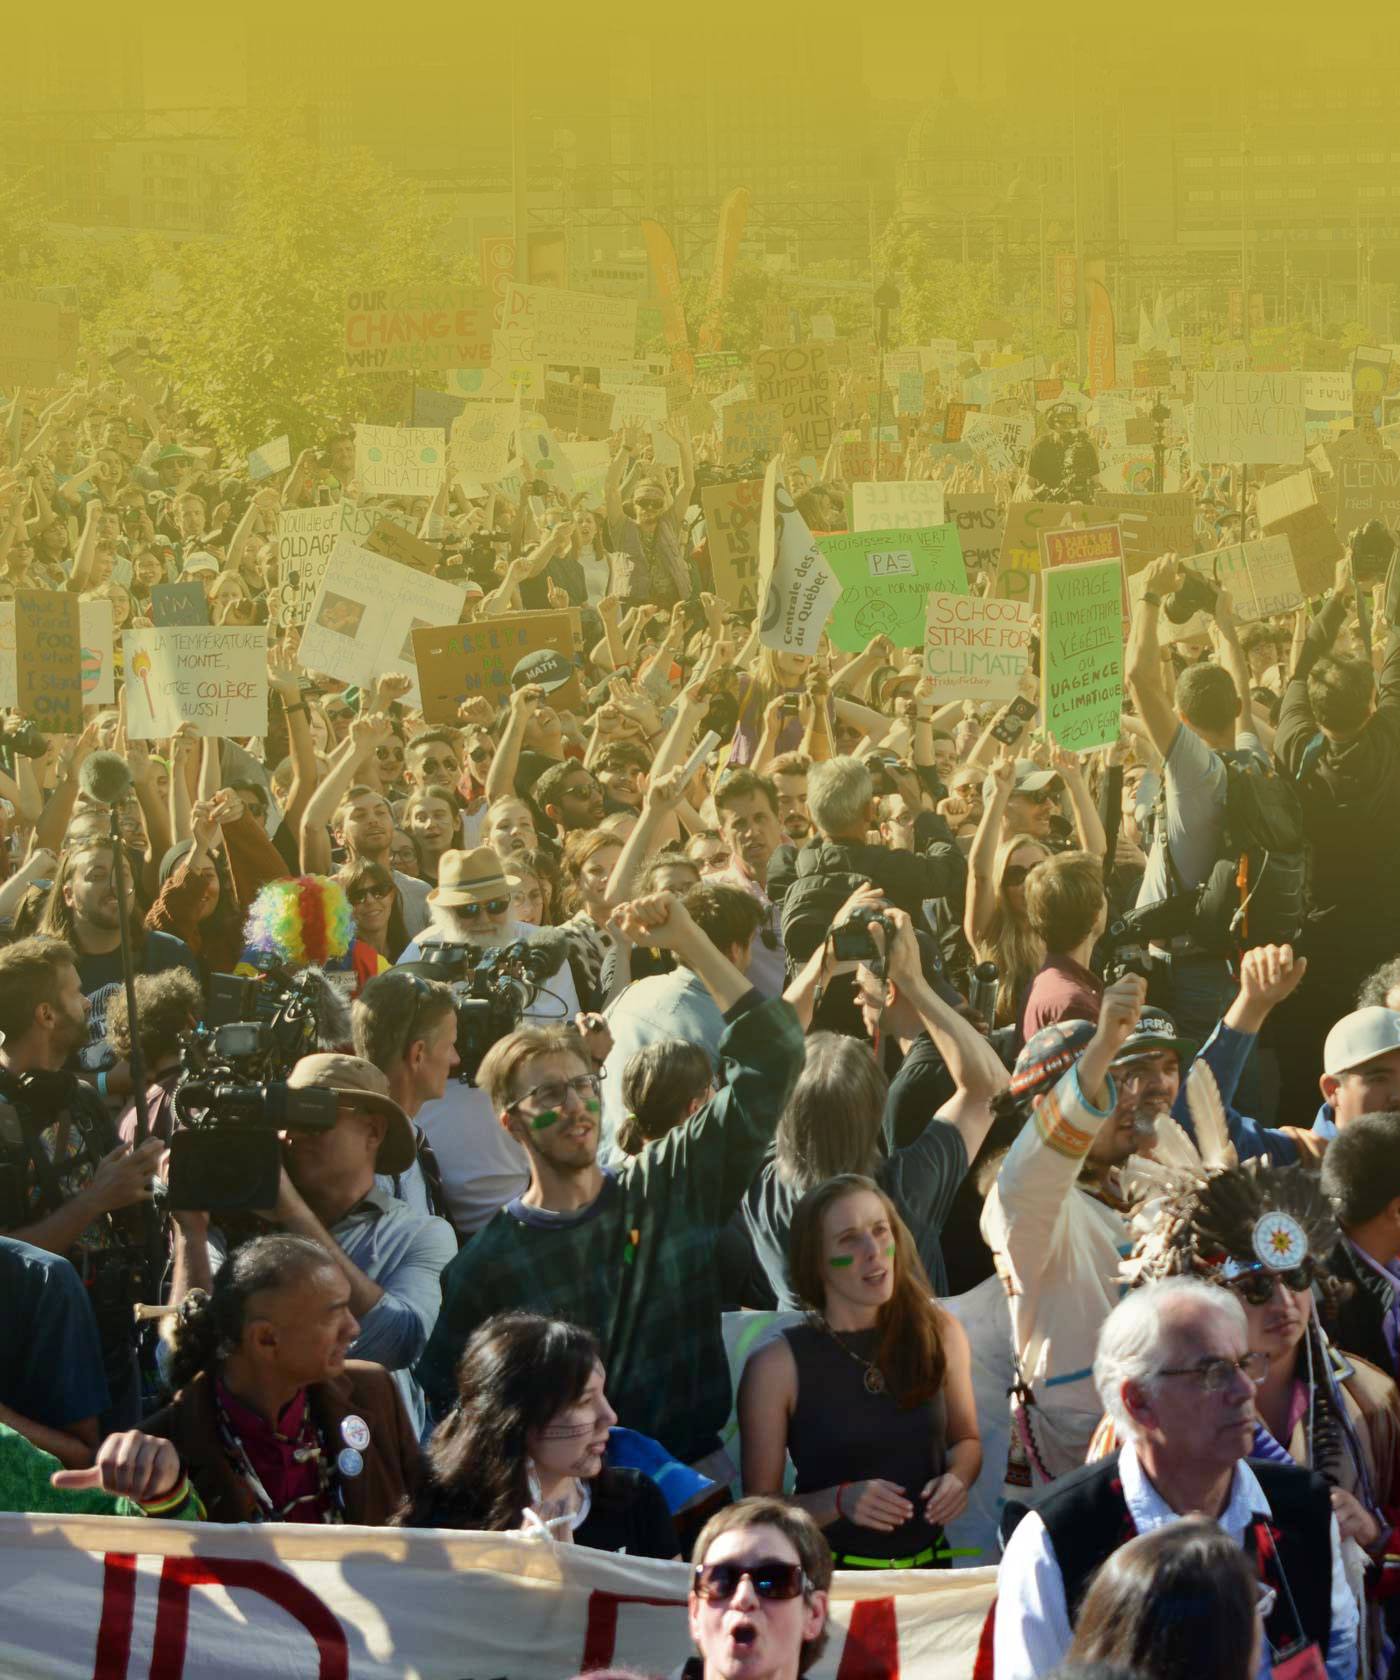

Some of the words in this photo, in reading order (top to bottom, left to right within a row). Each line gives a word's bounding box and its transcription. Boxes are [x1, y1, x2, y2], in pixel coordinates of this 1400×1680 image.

[349, 290, 387, 312] OUR
[346, 309, 480, 348] CHANGE
[347, 348, 388, 368] WHY
[456, 344, 492, 361] WE
[756, 347, 826, 380] STOP
[758, 371, 829, 403] PIMPING
[280, 535, 308, 561] OLD
[917, 530, 948, 548] VERT
[1066, 542, 1115, 560] OCTOBRE
[871, 551, 913, 574] PAS
[1056, 572, 1112, 601] VIRAGE
[783, 573, 807, 646] Centrale
[799, 554, 816, 579] des
[797, 571, 830, 631] Québec
[936, 597, 1033, 624] SCHOOL
[1048, 600, 1121, 628] ALIMENTAIRE
[35, 632, 75, 649] FOR
[796, 632, 808, 647] du
[927, 626, 997, 648] STRIKE
[999, 628, 1029, 649] FOR
[176, 653, 232, 672] MONTE,
[526, 657, 559, 682] MATH
[926, 647, 1029, 676] CLIMATE
[1078, 657, 1095, 673] OU
[196, 679, 259, 700] COLÈRE
[1050, 662, 1119, 698] URGENCE
[33, 695, 72, 716] ON
[180, 700, 221, 719] AUSSI
[1051, 685, 1121, 718] CLIMATIQUE
